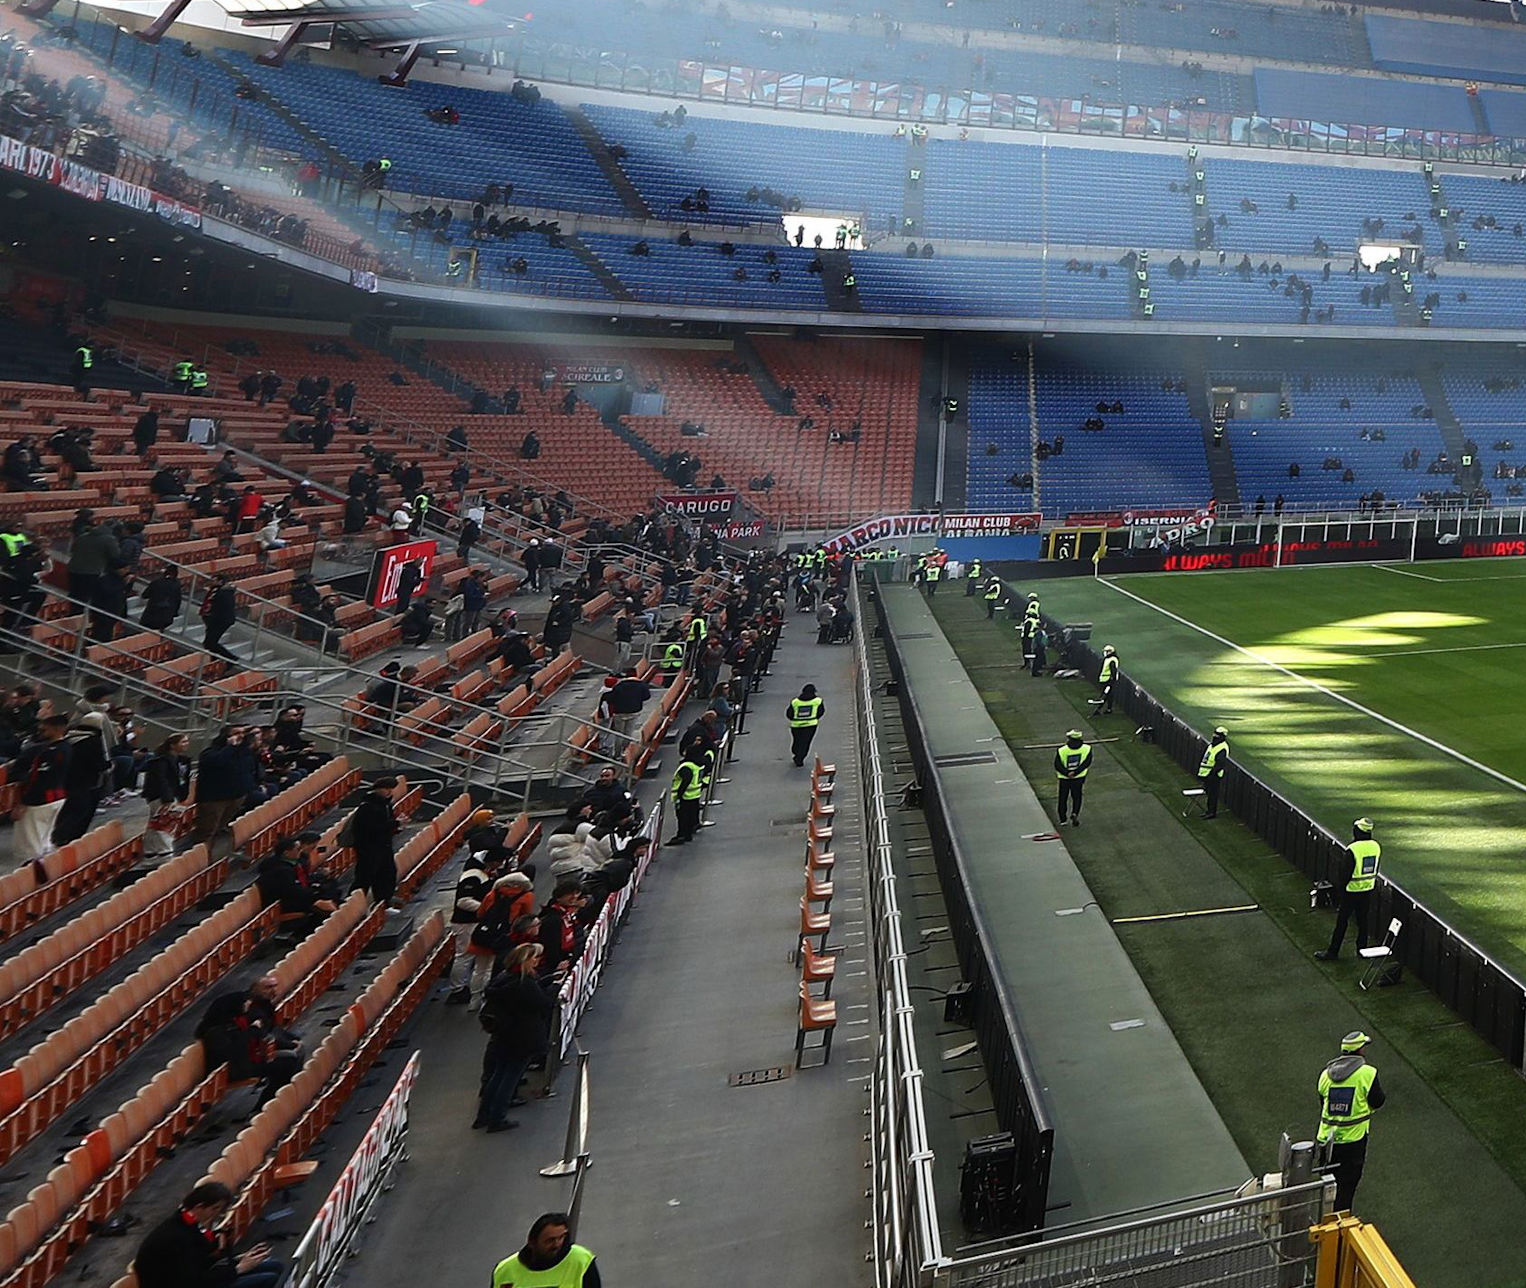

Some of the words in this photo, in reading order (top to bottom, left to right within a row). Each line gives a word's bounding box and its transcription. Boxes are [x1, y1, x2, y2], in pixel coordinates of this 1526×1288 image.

[665, 500, 731, 513] CARUGO
[944, 517, 980, 529] MILAN
[983, 516, 1011, 528] CLUB
[731, 526, 760, 539] PARK
